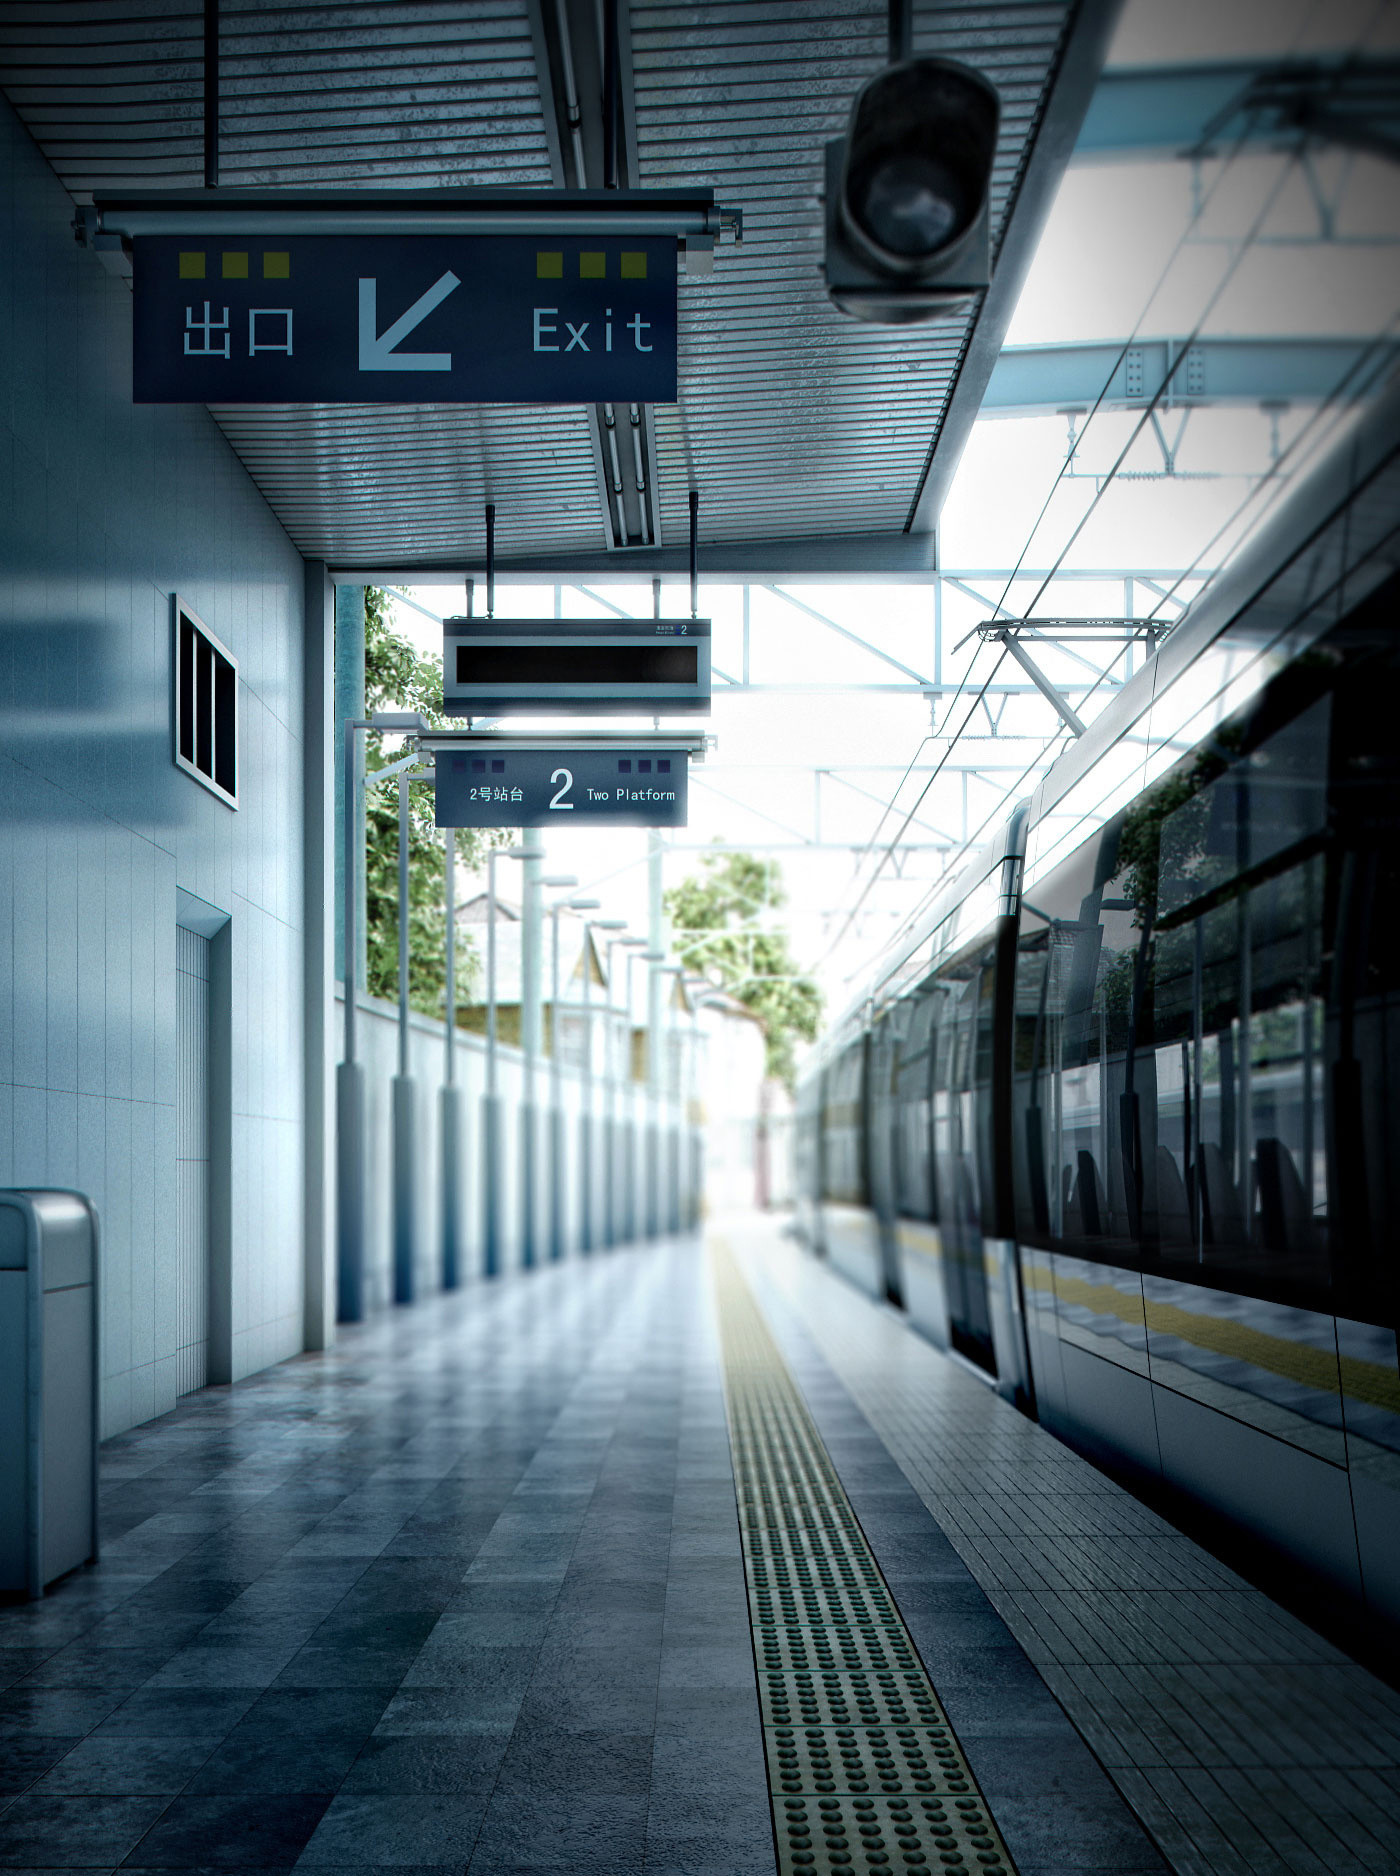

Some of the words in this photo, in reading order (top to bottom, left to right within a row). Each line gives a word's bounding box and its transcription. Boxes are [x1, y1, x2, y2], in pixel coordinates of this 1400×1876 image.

[184, 301, 294, 359] 出口
[532, 308, 653, 352] Exit
[680, 624, 688, 635] 2
[470, 787, 523, 802] 2号站台
[549, 768, 574, 809] 2
[587, 788, 608, 801] Two
[616, 788, 675, 801] Platform
